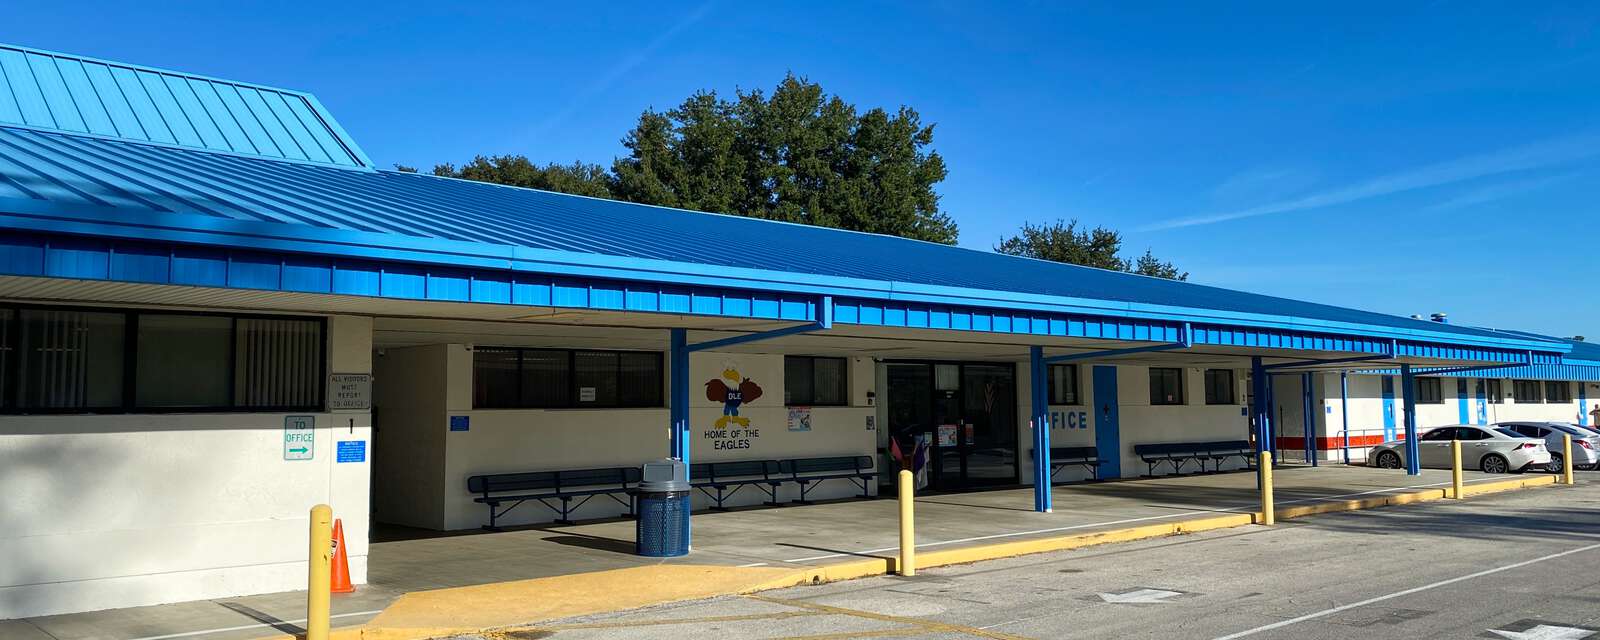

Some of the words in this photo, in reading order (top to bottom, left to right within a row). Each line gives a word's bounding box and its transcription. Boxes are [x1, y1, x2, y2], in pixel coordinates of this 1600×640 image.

[728, 392, 742, 400] DLE
[1051, 411, 1087, 429] FICE
[294, 421, 306, 430] TO
[286, 433, 313, 442] OFFICE
[704, 430, 727, 439] HOME
[731, 430, 741, 439] OF
[744, 429, 760, 438] THE
[714, 439, 750, 450] EAGLES
